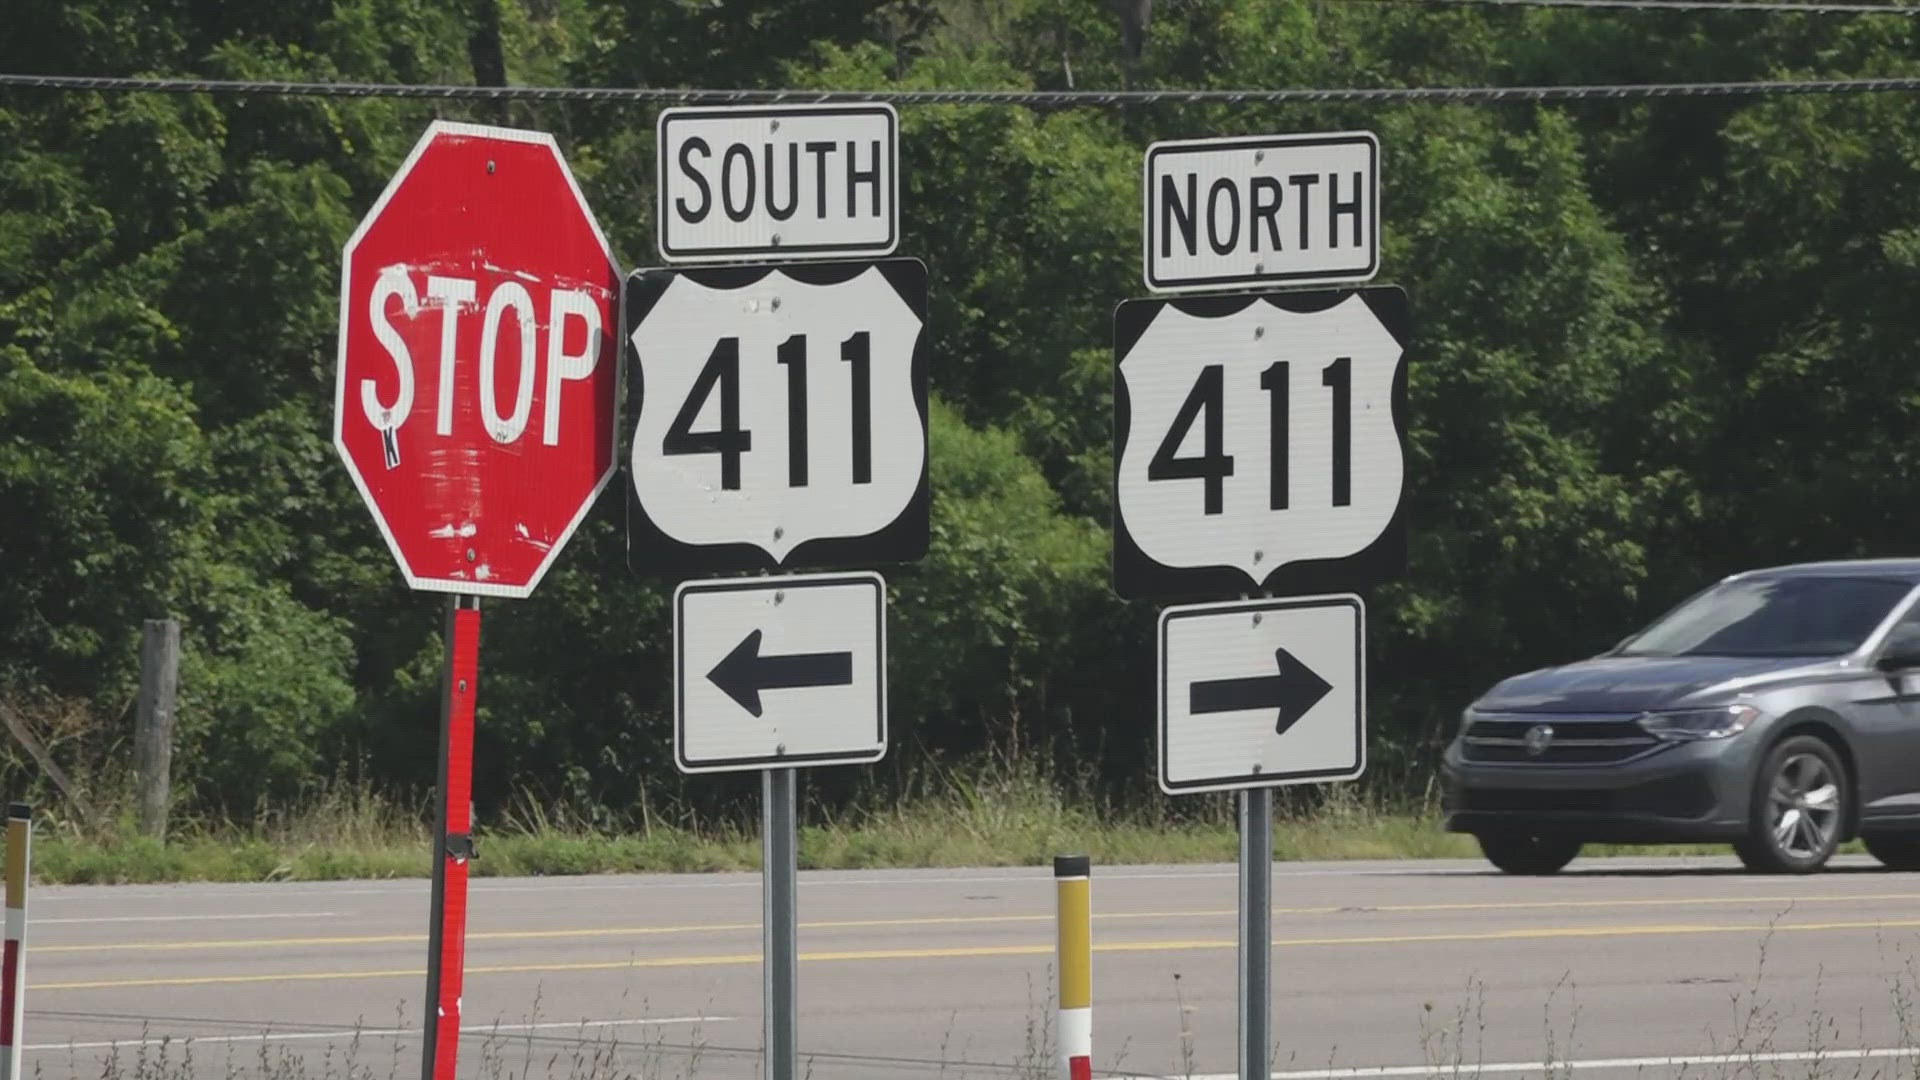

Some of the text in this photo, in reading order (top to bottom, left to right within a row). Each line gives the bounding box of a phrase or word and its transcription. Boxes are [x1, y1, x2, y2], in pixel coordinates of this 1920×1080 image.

[676, 136, 881, 224] SOUTH
[1161, 171, 1363, 258] NORTH
[361, 264, 602, 446] STOP
[662, 331, 872, 491] 411
[1148, 357, 1352, 516] 411
